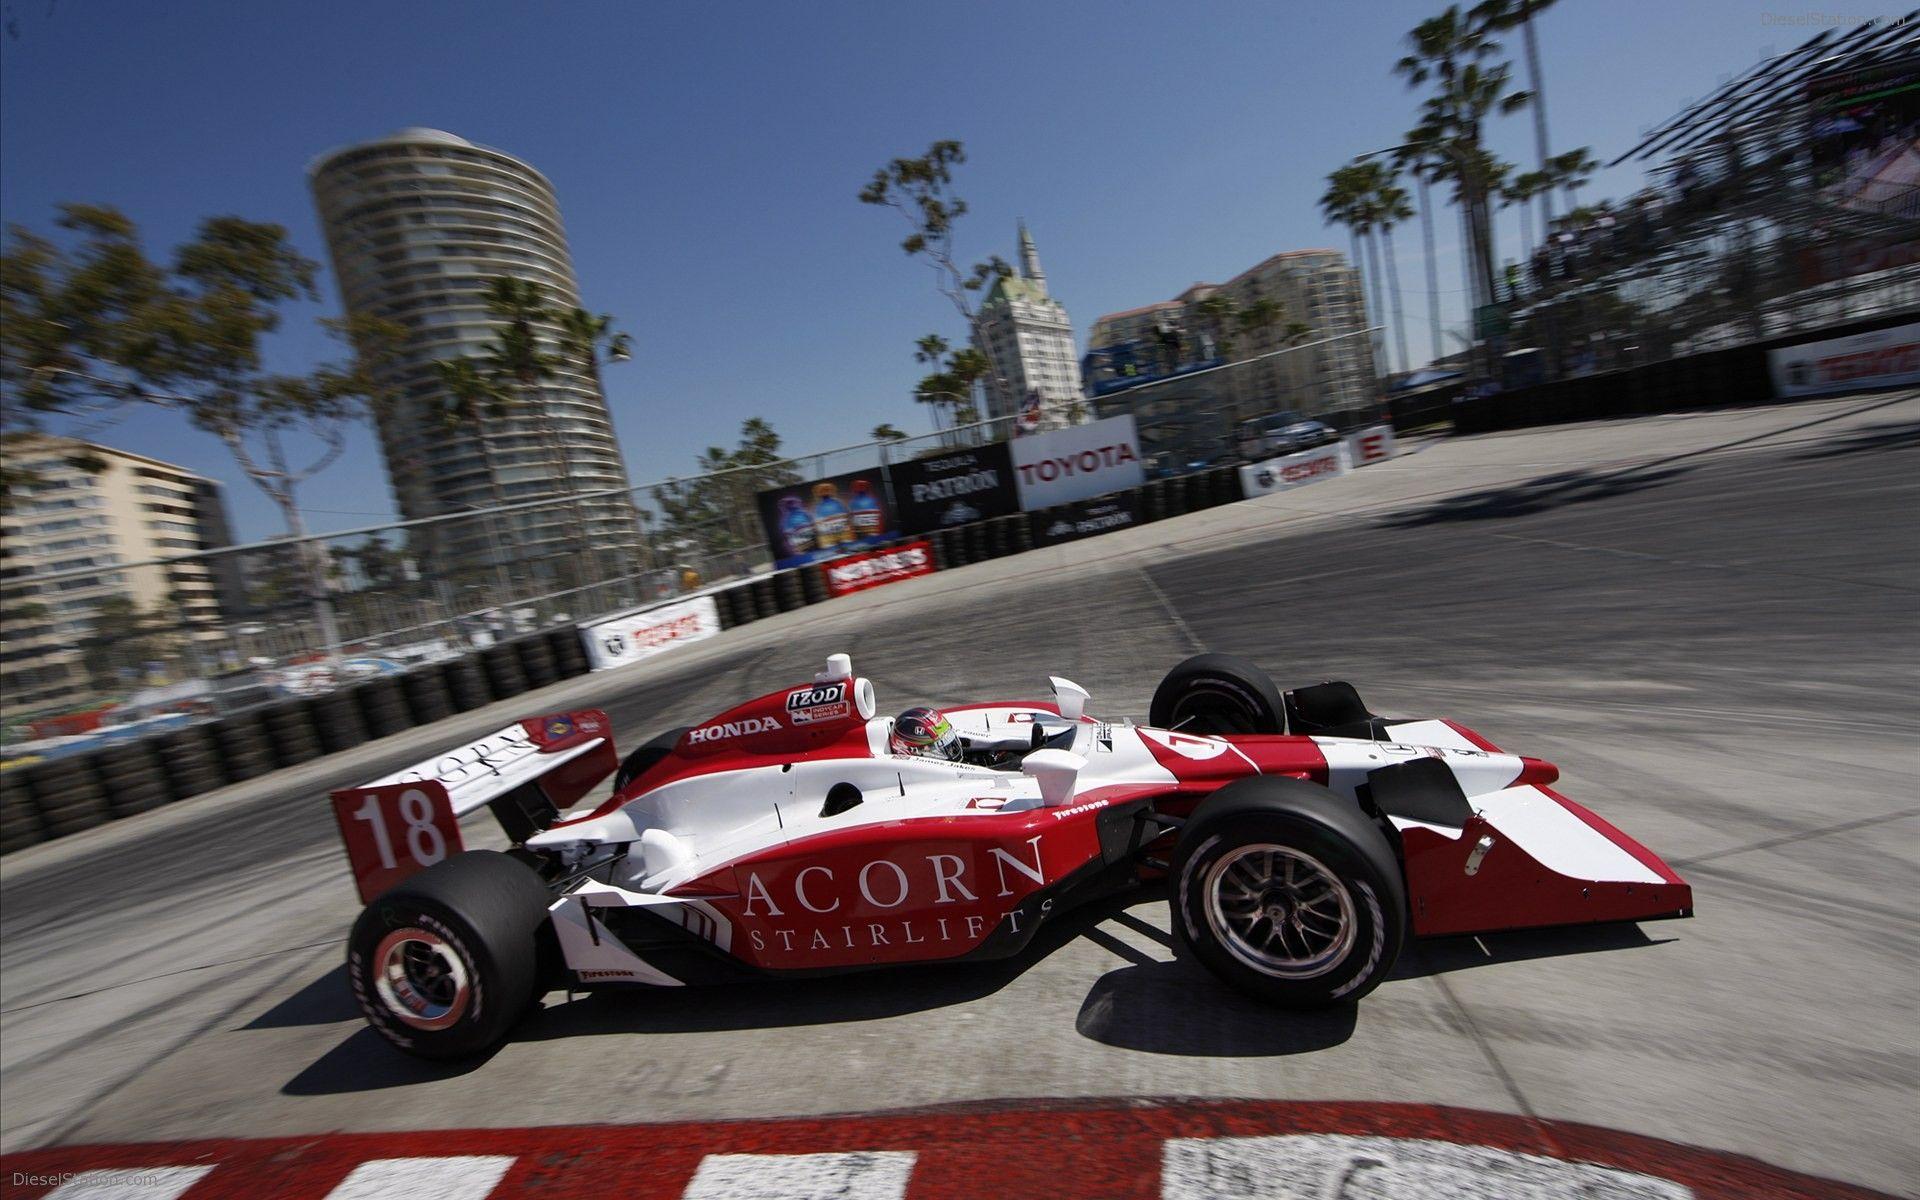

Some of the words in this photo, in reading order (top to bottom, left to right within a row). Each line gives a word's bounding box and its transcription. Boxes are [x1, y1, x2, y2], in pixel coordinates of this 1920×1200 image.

[1359, 434, 1390, 460] E
[1015, 443, 1137, 485] TOYOTA
[791, 687, 839, 708] IZOD
[812, 703, 844, 714] INDYCAR
[813, 709, 840, 719] SERIES
[688, 716, 783, 745] HONDA
[1052, 799, 1109, 820] Firestone
[354, 789, 446, 869] 18
[743, 835, 1046, 917] ACORN
[751, 898, 1054, 952] STAIRLIFTS
